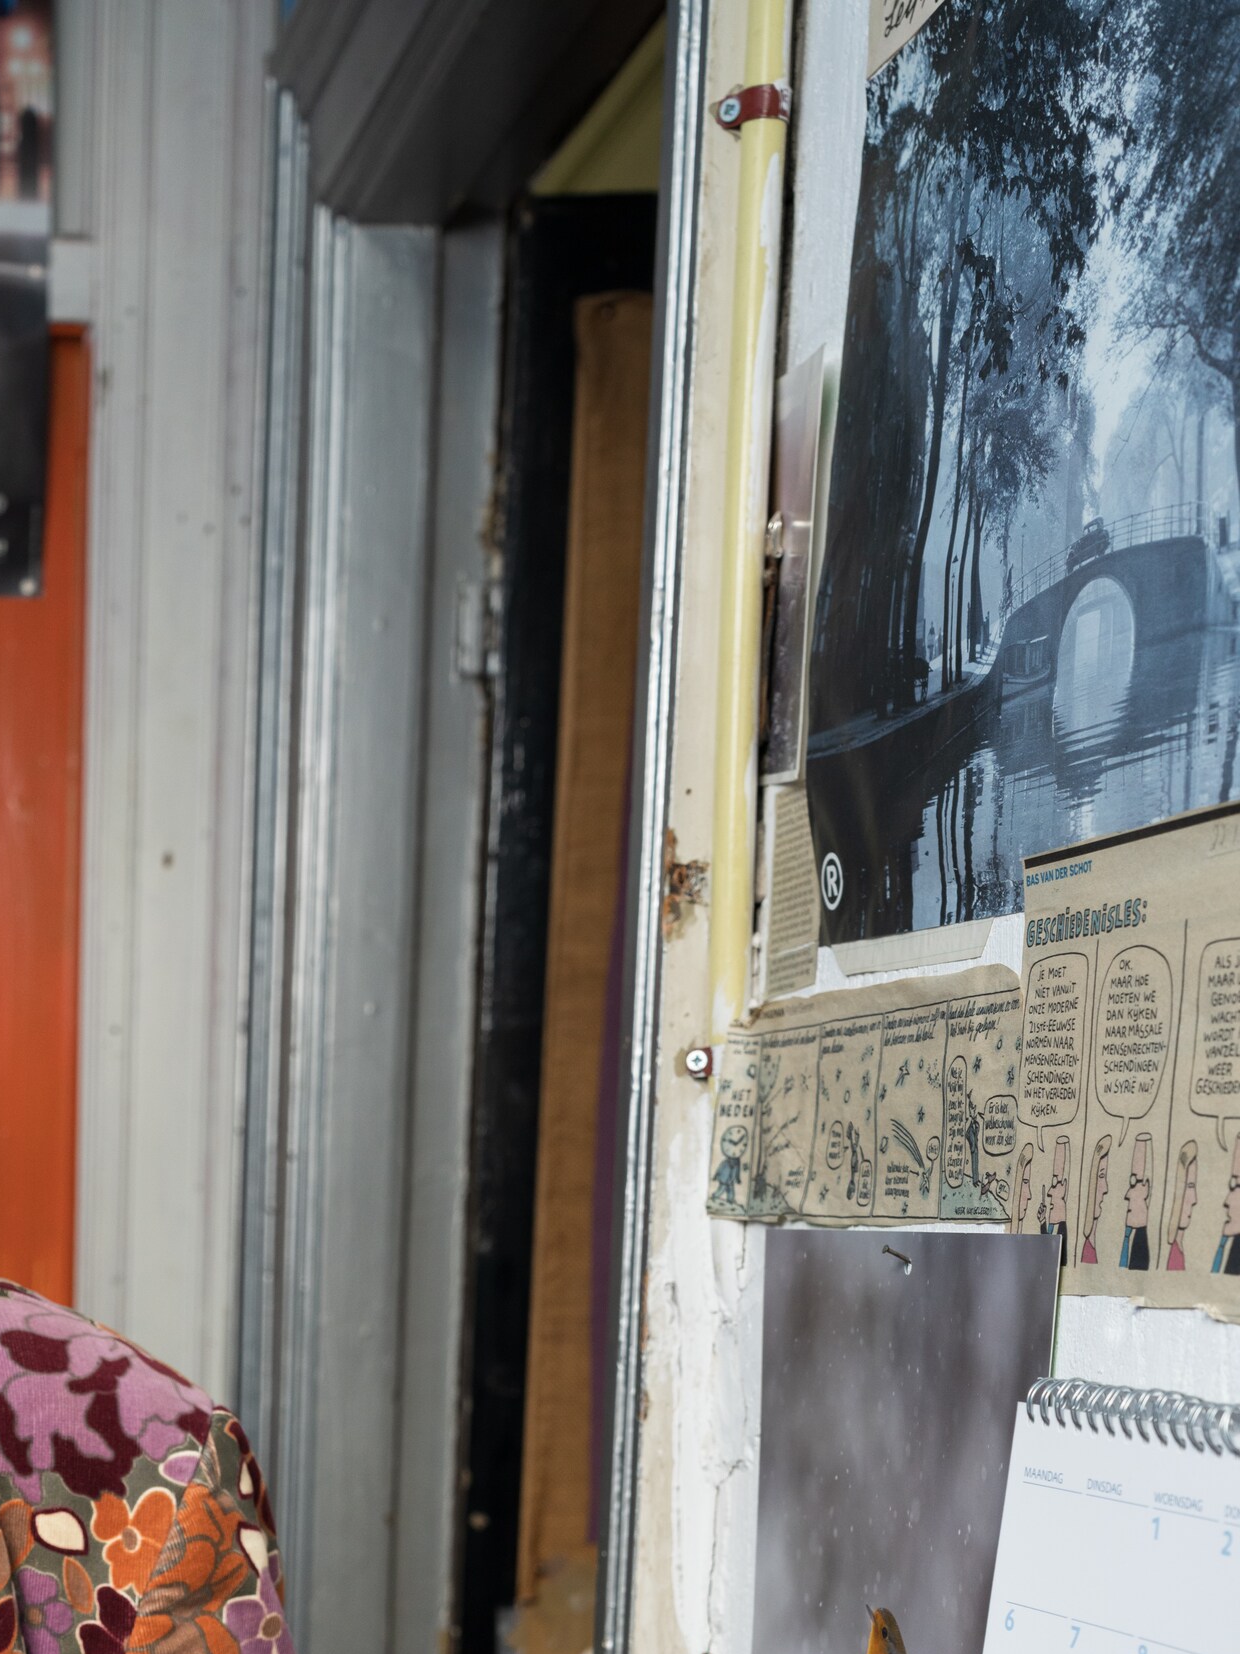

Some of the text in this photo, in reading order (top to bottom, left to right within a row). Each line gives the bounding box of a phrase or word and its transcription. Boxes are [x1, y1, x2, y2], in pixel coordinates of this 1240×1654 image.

[1026, 860, 1093, 887] BAS VAN DER SCHOT
[1214, 955, 1232, 969] ALS
[1048, 966, 1067, 979] MOET
[1208, 971, 1235, 988] MAAR
[1035, 981, 1077, 999] NIET VANUIT
[1111, 974, 1150, 989] MAAR HOE
[1029, 997, 1079, 1015] ONZE MODERNE
[1108, 990, 1157, 1005] MOETEN WE
[1106, 1009, 1125, 1021] DAN
[1105, 1022, 1163, 1039] NAAR MASSALE
[1026, 1036, 1074, 1051] NORMEN NAAR
[1102, 1041, 1167, 1056] MENSENRECHTEN-
[1024, 1053, 1080, 1068] MENSENRECHTEN-
[1104, 1057, 1159, 1074] SCHENDINGEN
[1026, 1070, 1074, 1085] SCHENDINGEN
[1208, 1062, 1233, 1077] WEER
[1033, 1087, 1045, 1099] HET
[1046, 1088, 1076, 1100] VERLEDEN
[1138, 1078, 1155, 1094] NU?
[1024, 1466, 1064, 1484] MAANDAG
[1086, 1478, 1123, 1496] DINSDAG
[1153, 1492, 1203, 1511] WOENSDAG
[1151, 1516, 1161, 1541] 1
[1220, 1529, 1234, 1557] 2
[1003, 1609, 1016, 1633] 6
[1070, 1625, 1082, 1649] 7
